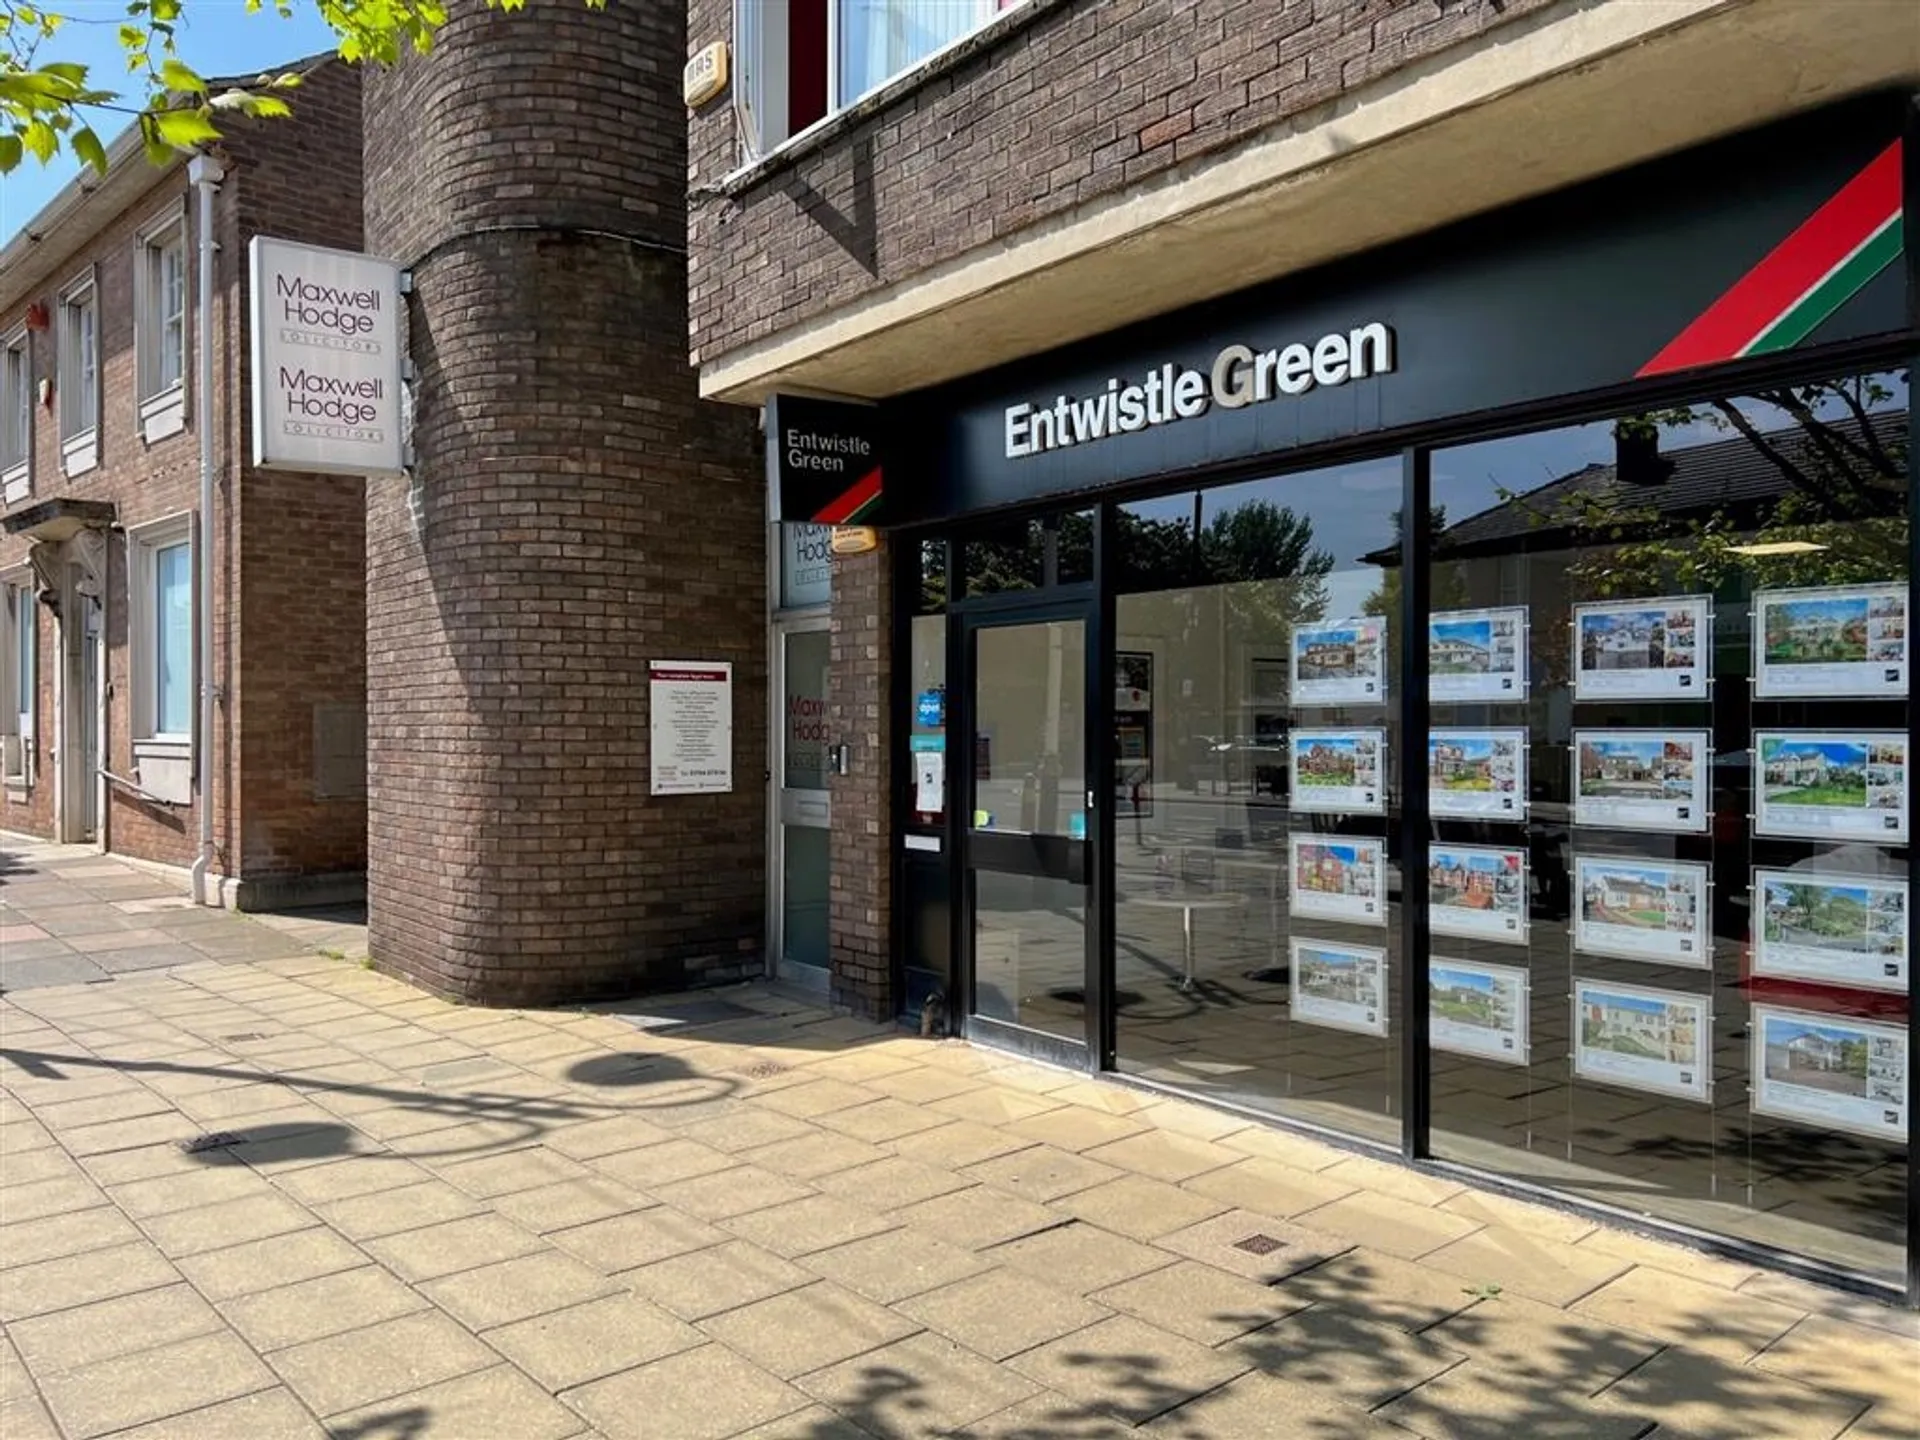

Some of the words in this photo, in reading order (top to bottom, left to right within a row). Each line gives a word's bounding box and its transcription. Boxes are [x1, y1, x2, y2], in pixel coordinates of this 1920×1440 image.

[276, 273, 381, 311] Maxwell
[285, 299, 375, 335] Hodge
[281, 329, 381, 354] SOLICITORS
[280, 366, 384, 401] Maxwell
[287, 391, 377, 425] Hodge
[284, 421, 385, 443] SOLICITORS
[786, 428, 871, 456] Entwistle
[787, 449, 844, 473] Green
